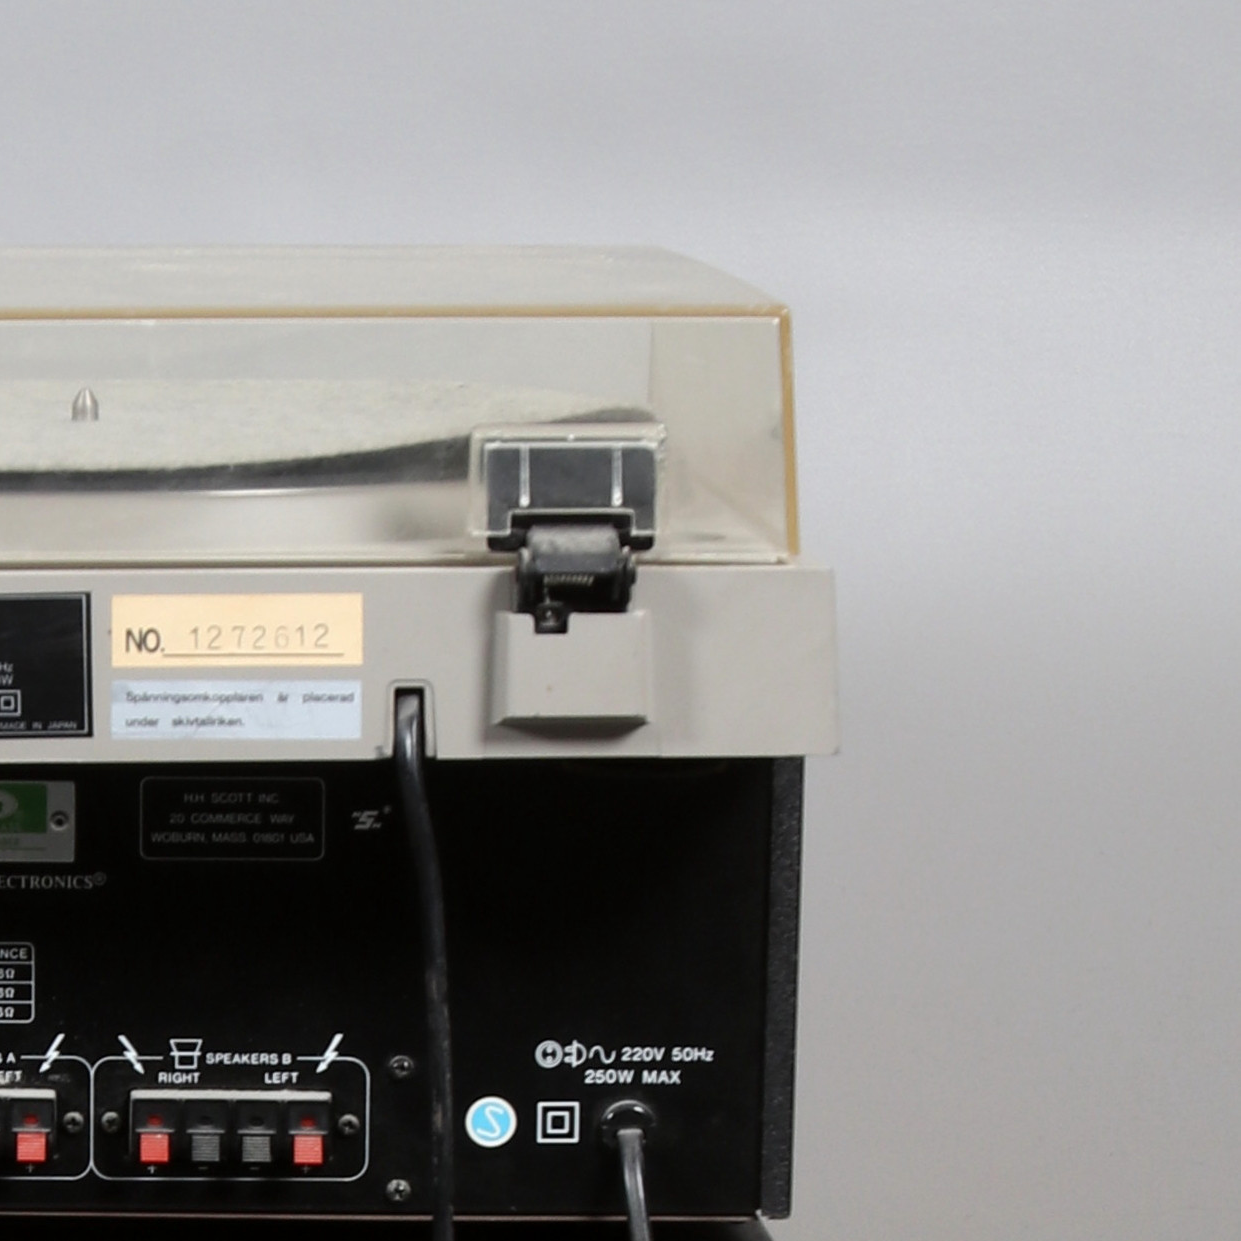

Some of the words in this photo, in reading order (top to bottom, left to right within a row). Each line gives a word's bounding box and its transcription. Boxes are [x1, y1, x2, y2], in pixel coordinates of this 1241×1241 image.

[125, 627, 165, 654] NO.
[6, 1051, 16, 1064] A
[205, 1052, 280, 1066] SPEAKERS
[281, 1052, 292, 1066] B
[620, 1046, 666, 1062] 220V
[671, 1046, 715, 1062] 50Hz
[157, 1071, 201, 1085] RIGHT
[264, 1071, 299, 1085] LEFT
[584, 1068, 635, 1085] 250W
[641, 1069, 681, 1085] MAX
